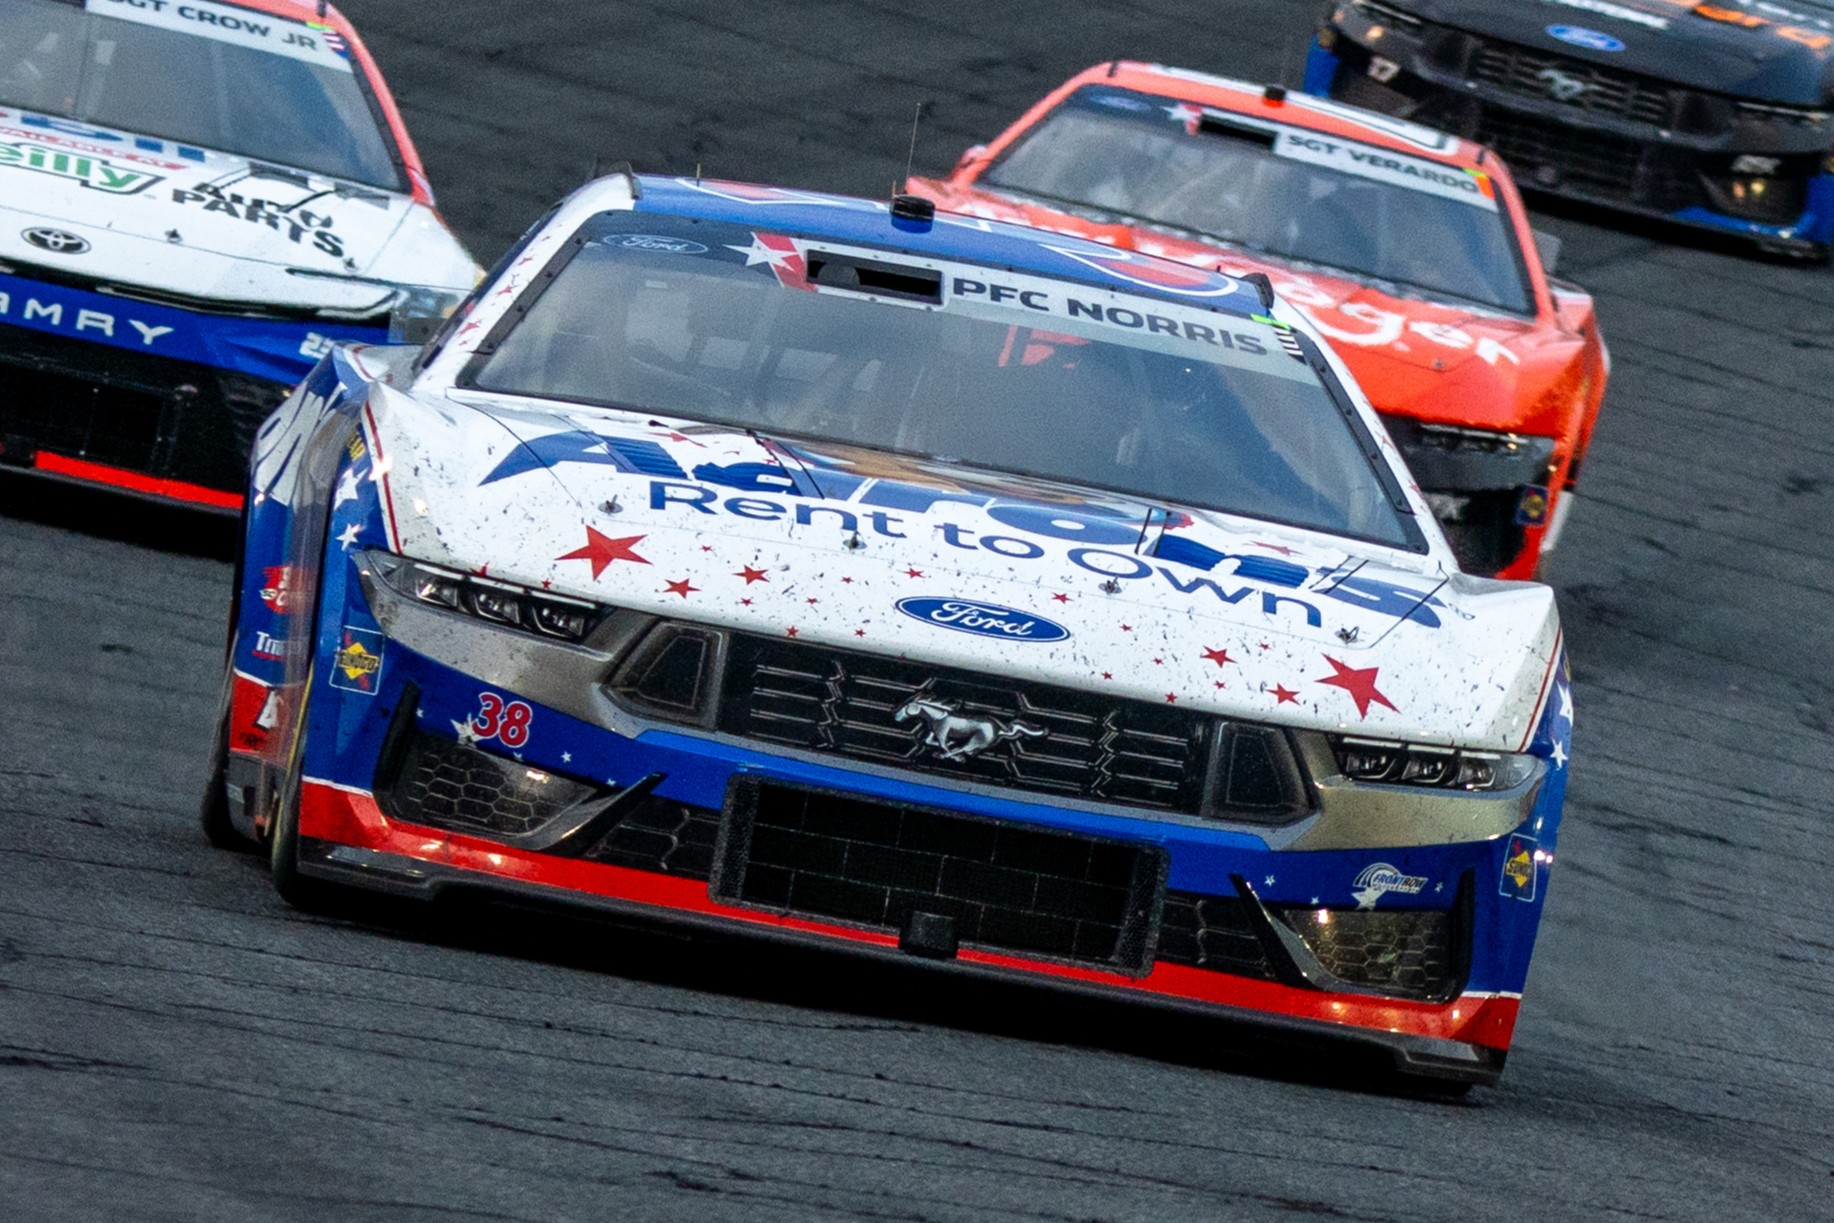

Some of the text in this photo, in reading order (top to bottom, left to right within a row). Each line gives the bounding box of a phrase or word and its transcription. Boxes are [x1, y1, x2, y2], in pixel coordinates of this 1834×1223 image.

[108, 0, 319, 50] GT CROW JR
[1289, 135, 1479, 193] SGT VERARDO
[172, 188, 344, 257] PARTS
[0, 291, 174, 345] MRY
[953, 277, 1267, 356] PFC NORRIS
[649, 480, 1323, 629] Rent to Own
[931, 601, 1035, 637] Ford
[472, 691, 533, 748] 38
